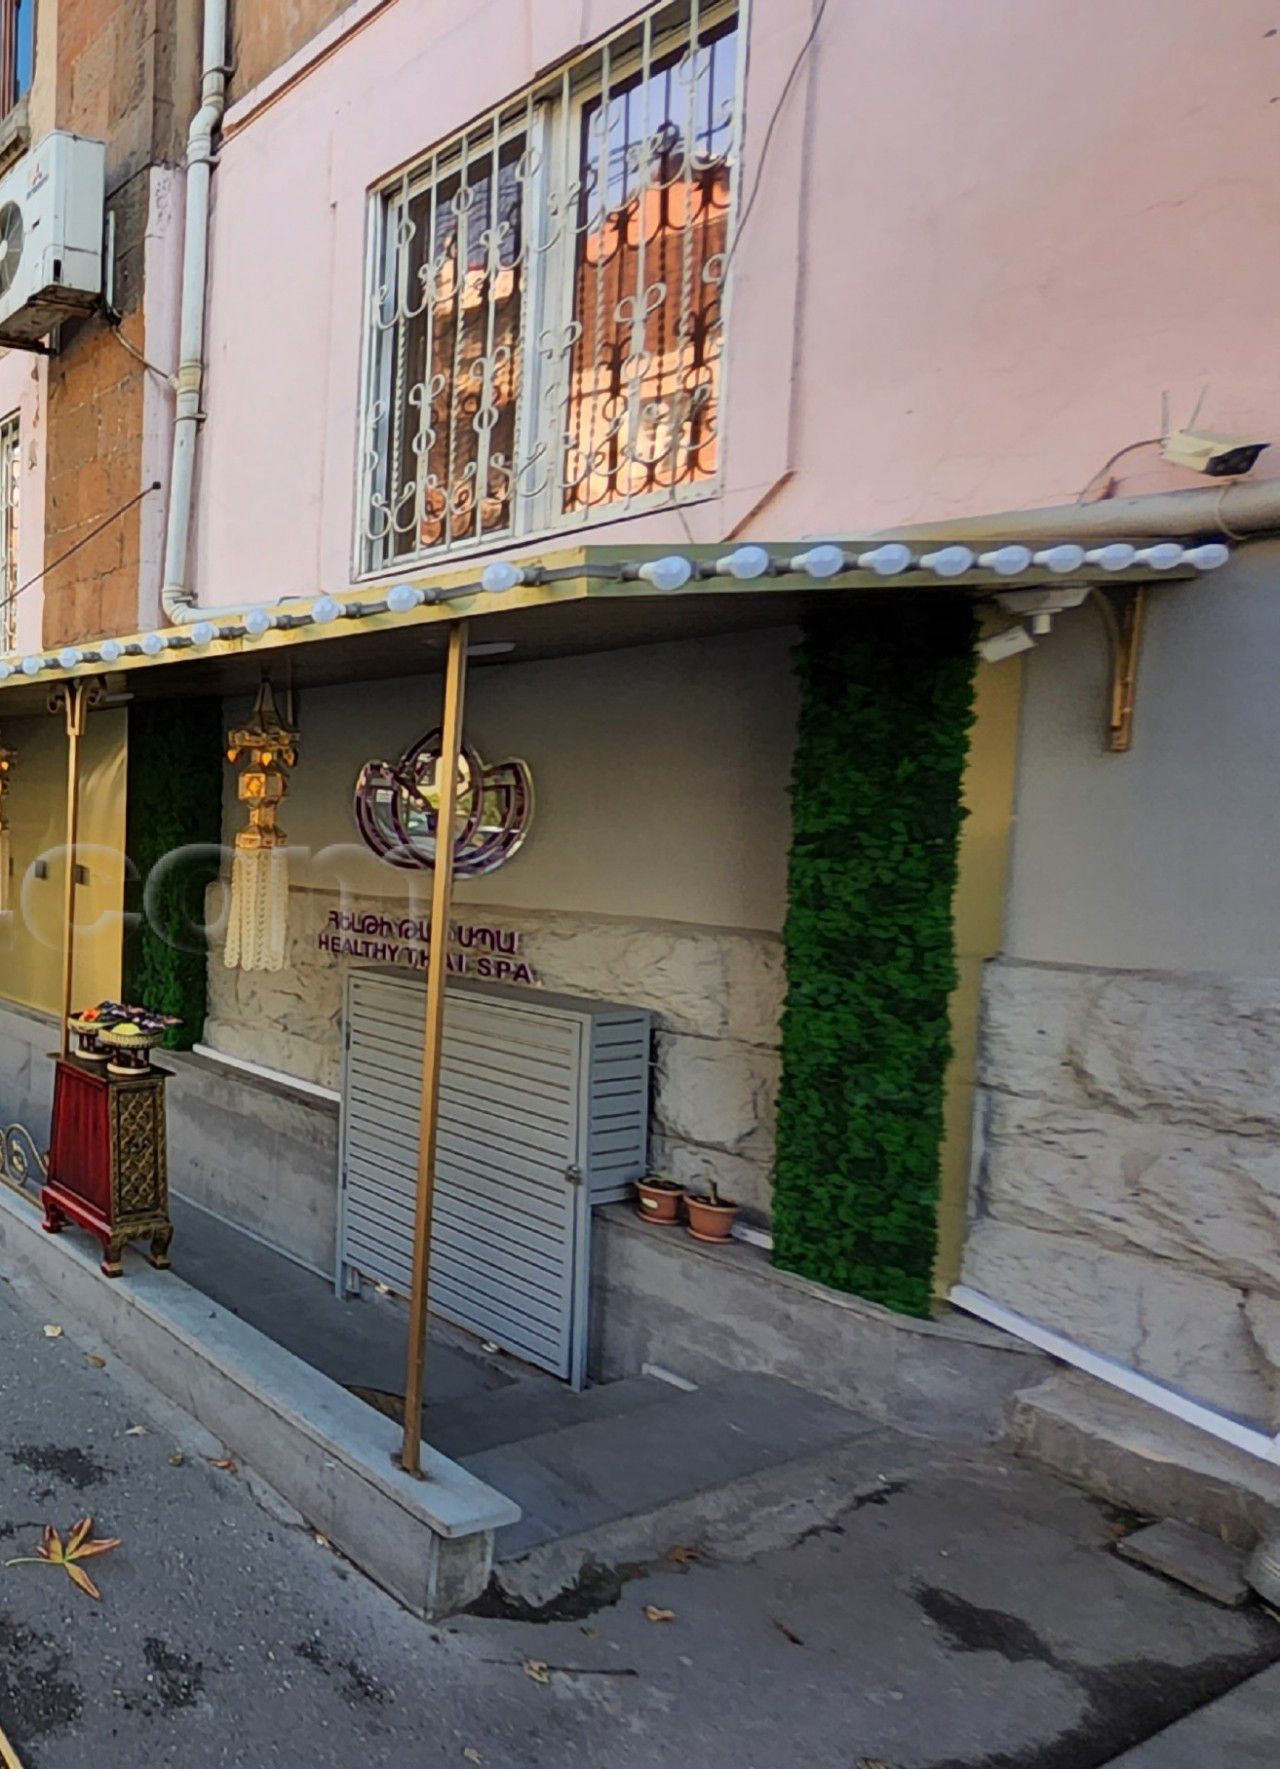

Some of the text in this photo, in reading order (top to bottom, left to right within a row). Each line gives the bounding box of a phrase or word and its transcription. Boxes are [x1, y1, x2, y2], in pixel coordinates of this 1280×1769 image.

[399, 918, 454, 944] ԹԱ
[318, 933, 399, 962] HEALTHY
[477, 957, 532, 985] SPA
